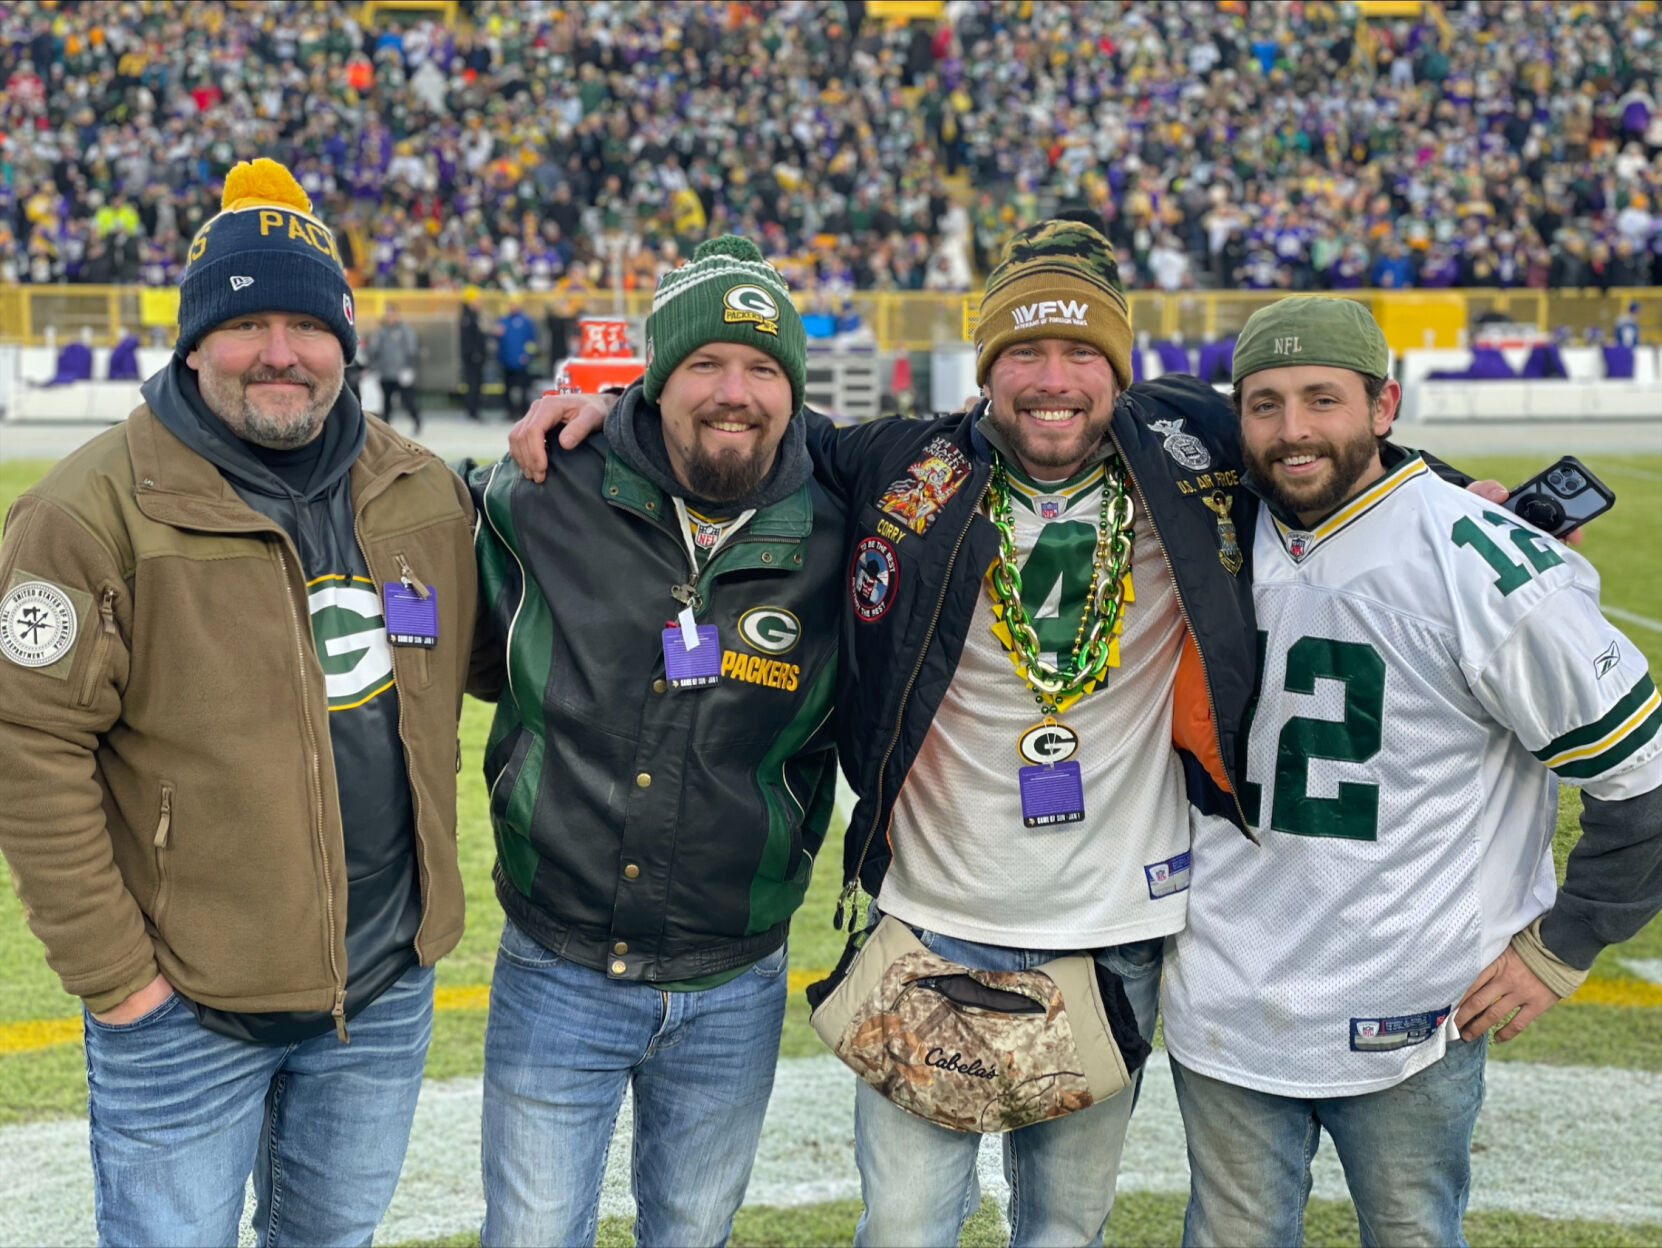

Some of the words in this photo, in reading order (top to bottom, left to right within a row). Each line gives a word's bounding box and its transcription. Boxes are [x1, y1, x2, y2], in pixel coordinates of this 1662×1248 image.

[727, 287, 777, 318] G
[1013, 300, 1088, 323] VFW
[726, 311, 762, 321] PACKERS
[1274, 336, 1302, 355] NFL
[1176, 480, 1197, 494] U.S.
[1196, 474, 1215, 490] AIR
[698, 533, 717, 547] NFL
[877, 518, 907, 545] CORRY
[876, 540, 888, 553] THE
[885, 552, 896, 572] BEST
[1451, 510, 1567, 598] 12
[12, 589, 36, 603] UNITED
[38, 590, 62, 608] STATES
[59, 609, 68, 618] OF
[53, 621, 69, 650] AMERICA
[744, 611, 797, 650] G
[6, 640, 45, 659] DEPARTMENT
[720, 650, 800, 692] PACKERS
[1022, 726, 1076, 763] G
[924, 1047, 999, 1080] Cabela's
